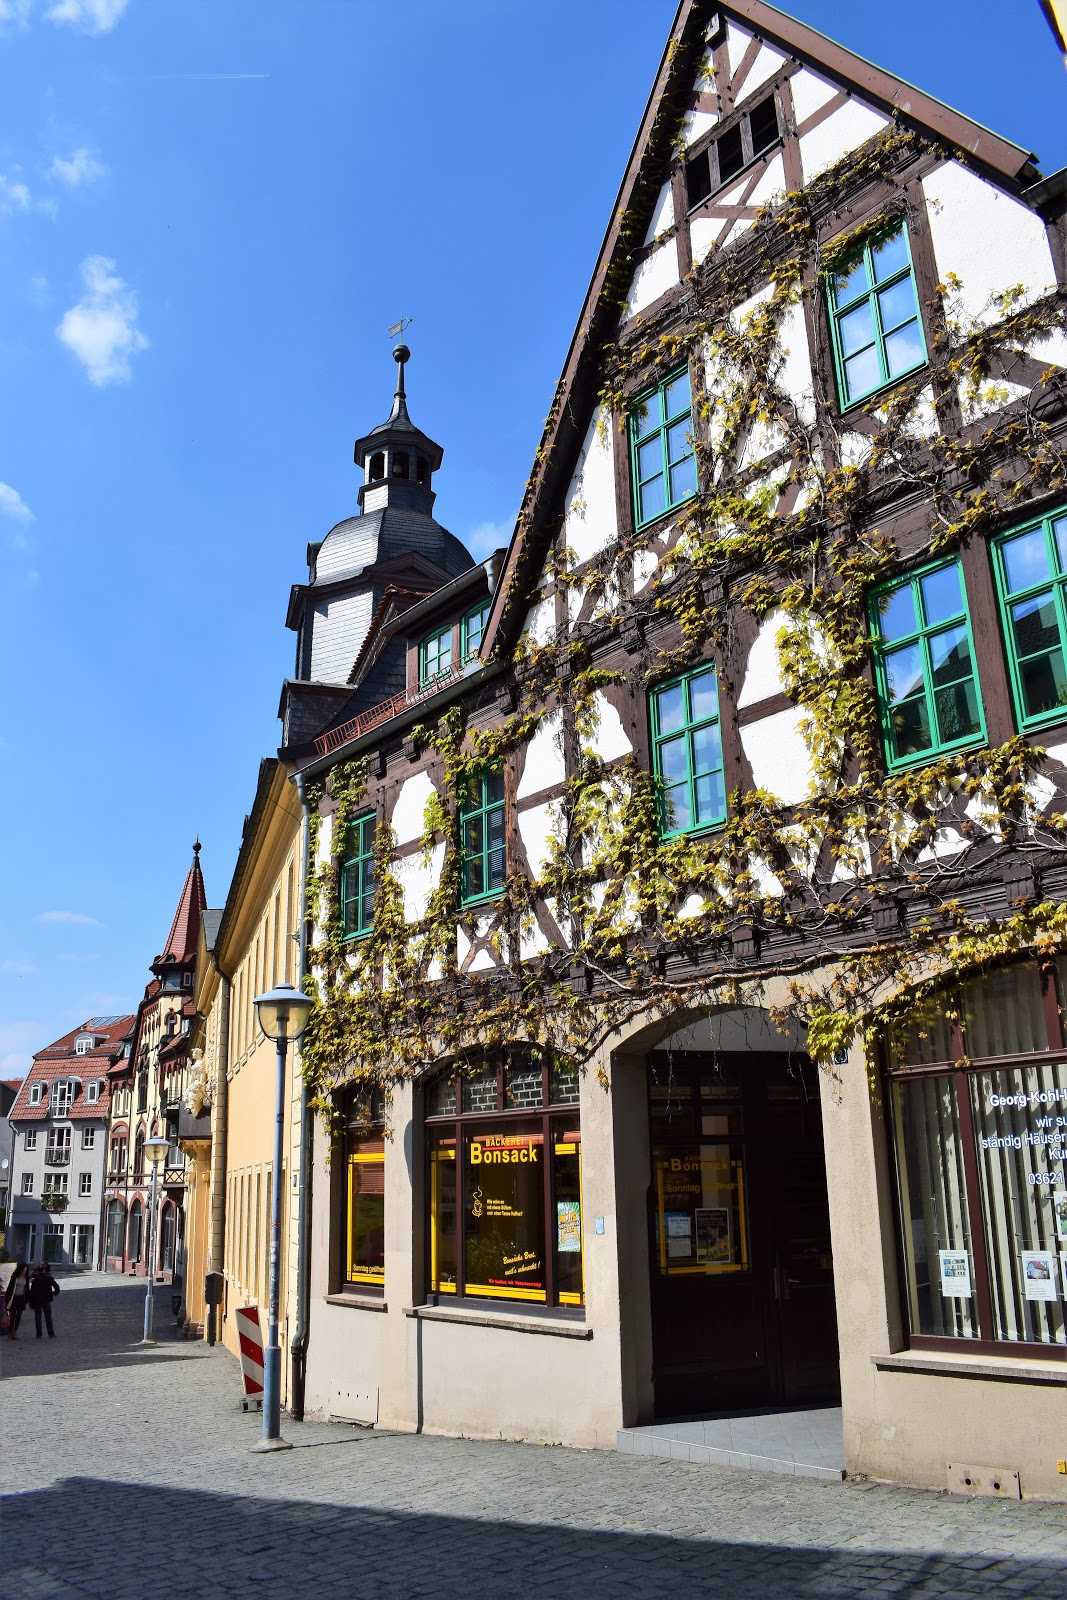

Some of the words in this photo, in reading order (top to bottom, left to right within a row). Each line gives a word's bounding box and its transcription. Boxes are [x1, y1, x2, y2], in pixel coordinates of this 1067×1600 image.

[1035, 1115, 1053, 1128] wir
[485, 1136, 524, 1147] BÄCKEREI
[981, 1135, 1022, 1149] ständig
[1024, 1132, 1066, 1146] Häuser
[470, 1139, 538, 1164] Bonsack
[1028, 1171, 1064, 1185] 03621
[666, 1184, 700, 1194] Sonntag
[352, 1263, 368, 1273] Sonntag
